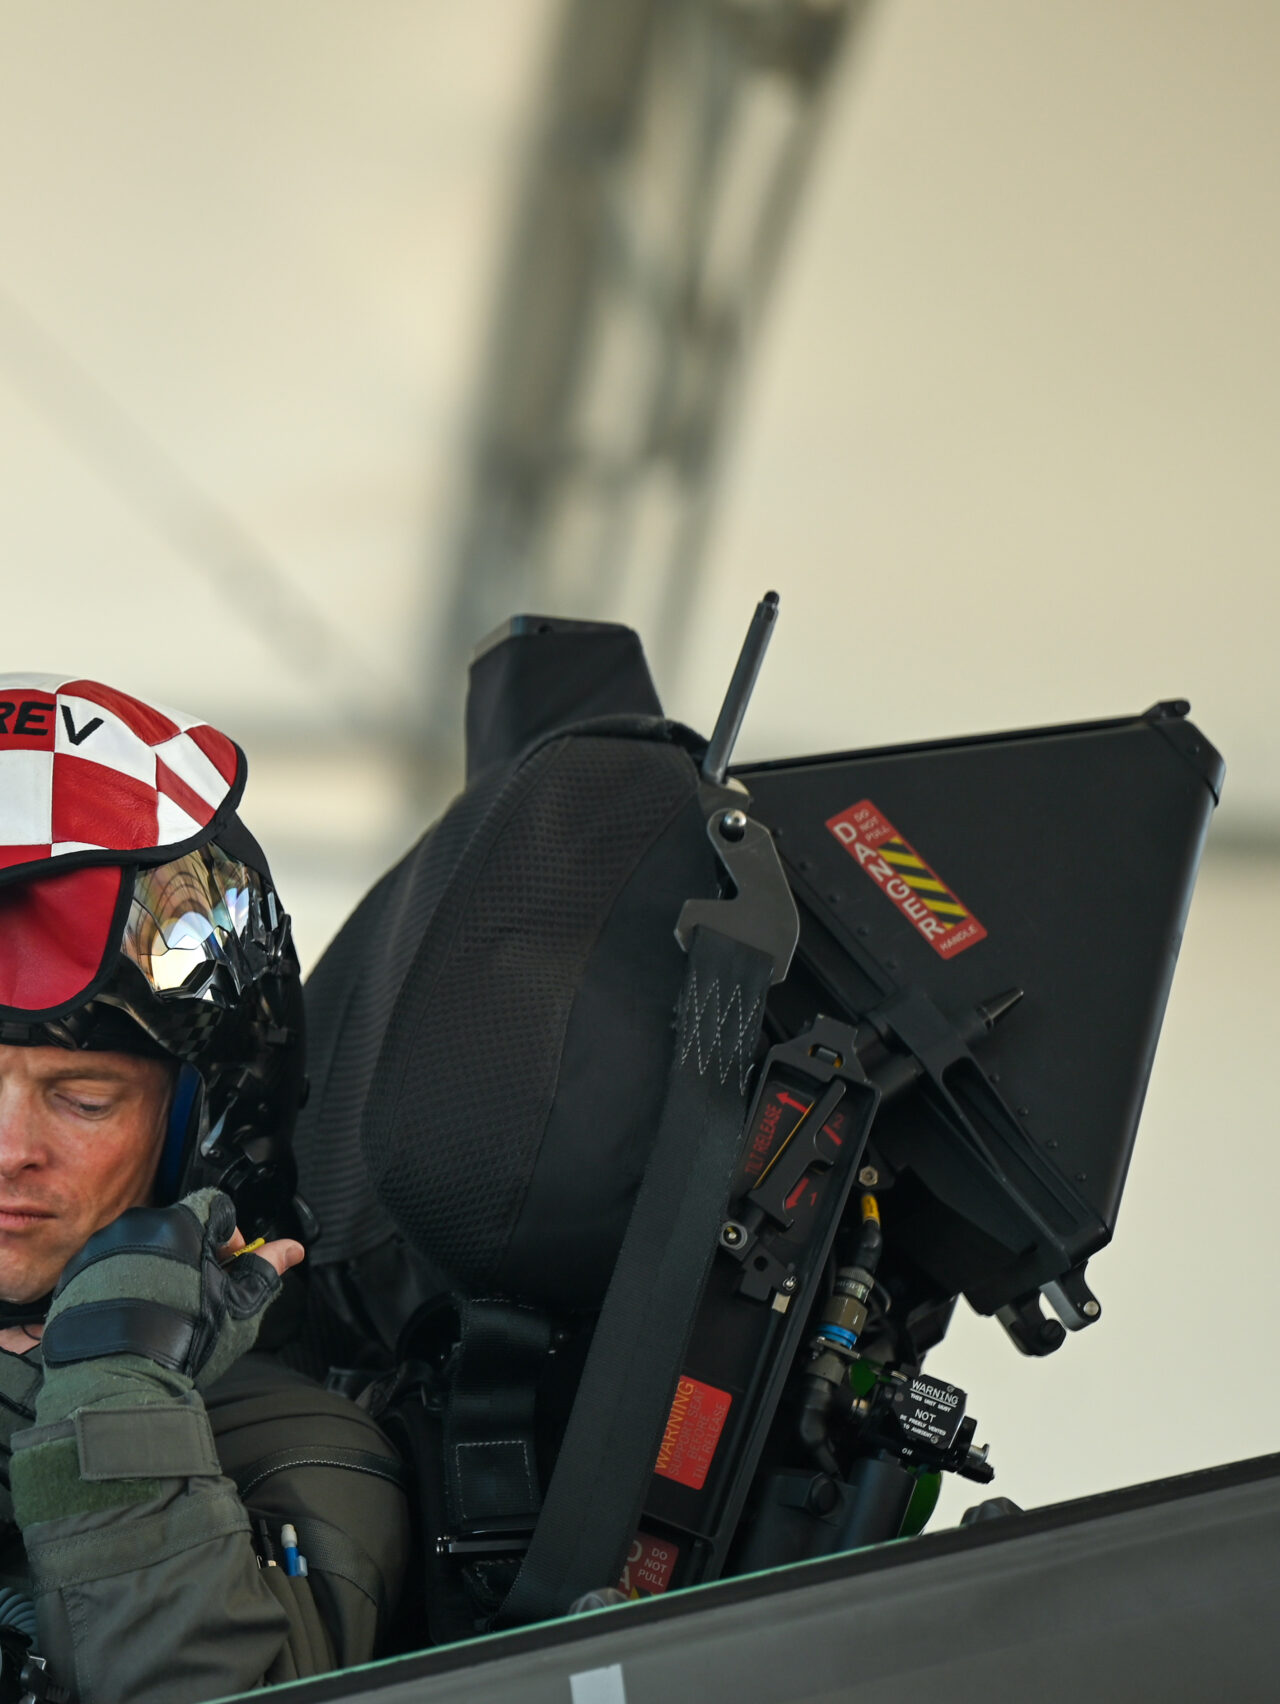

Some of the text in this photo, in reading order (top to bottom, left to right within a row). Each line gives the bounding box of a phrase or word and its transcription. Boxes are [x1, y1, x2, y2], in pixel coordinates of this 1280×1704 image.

[832, 821, 946, 940] DANGER
[833, 1114, 844, 1129] 2
[744, 1103, 783, 1175] TILT RELEASE
[810, 1192, 818, 1206] 1
[911, 1380, 959, 1405] WARNING
[655, 1381, 695, 1469] WARNING
[914, 1408, 937, 1423] NOT
[668, 1388, 705, 1476] SUPPORT SEAT
[687, 1415, 710, 1459] BEFORE
[693, 1402, 728, 1478] TILT RELEASE
[644, 1558, 668, 1574] NOT
[651, 1547, 668, 1561] DO
[637, 1569, 665, 1587] PULL
